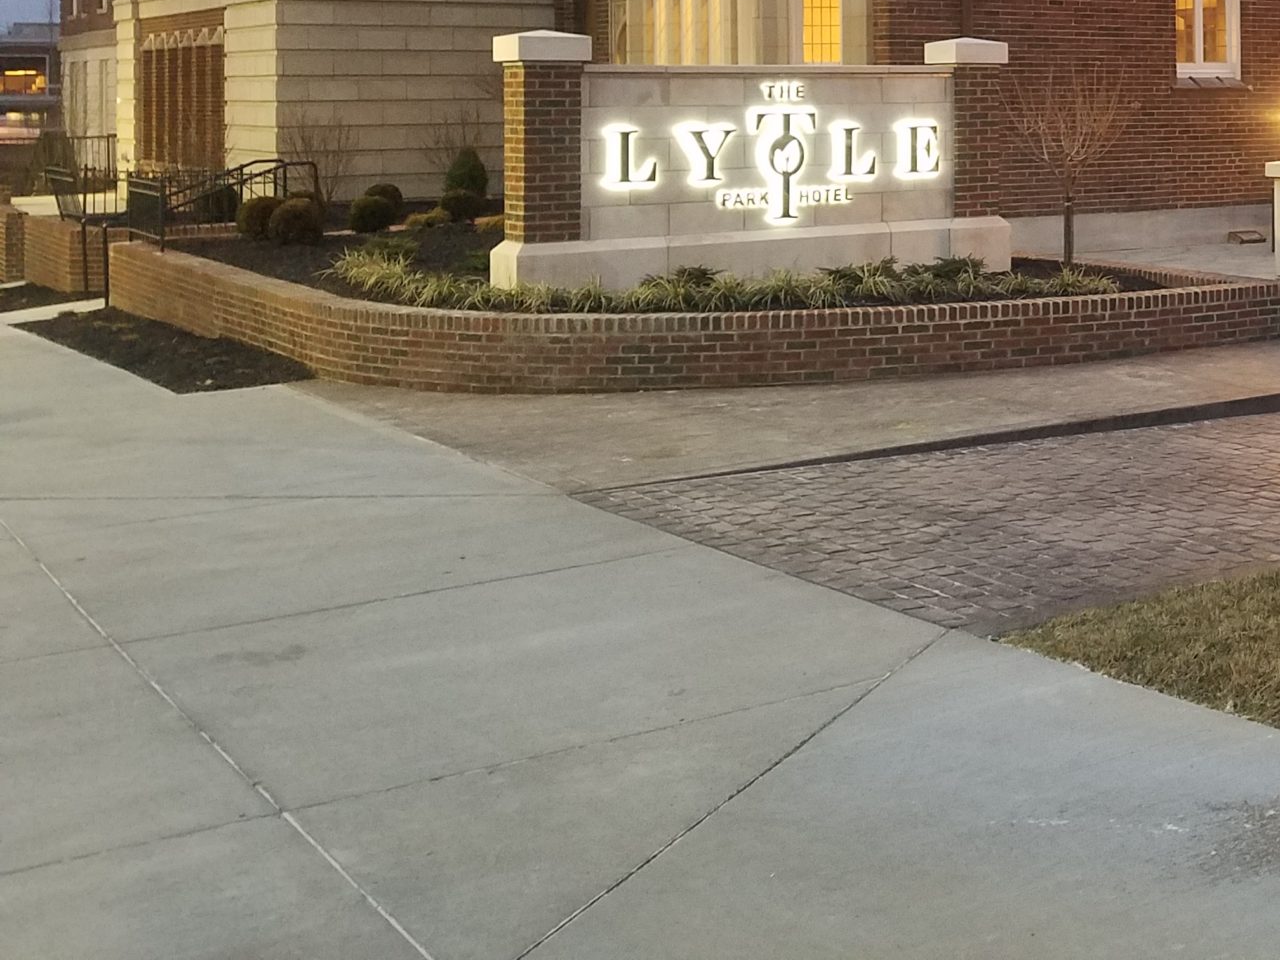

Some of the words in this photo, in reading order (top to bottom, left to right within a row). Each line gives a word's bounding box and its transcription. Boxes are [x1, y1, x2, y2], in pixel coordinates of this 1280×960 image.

[763, 83, 805, 99] THE
[606, 111, 940, 220] LYTLE
[720, 190, 770, 208] PARK
[799, 187, 854, 204] HOTEL
